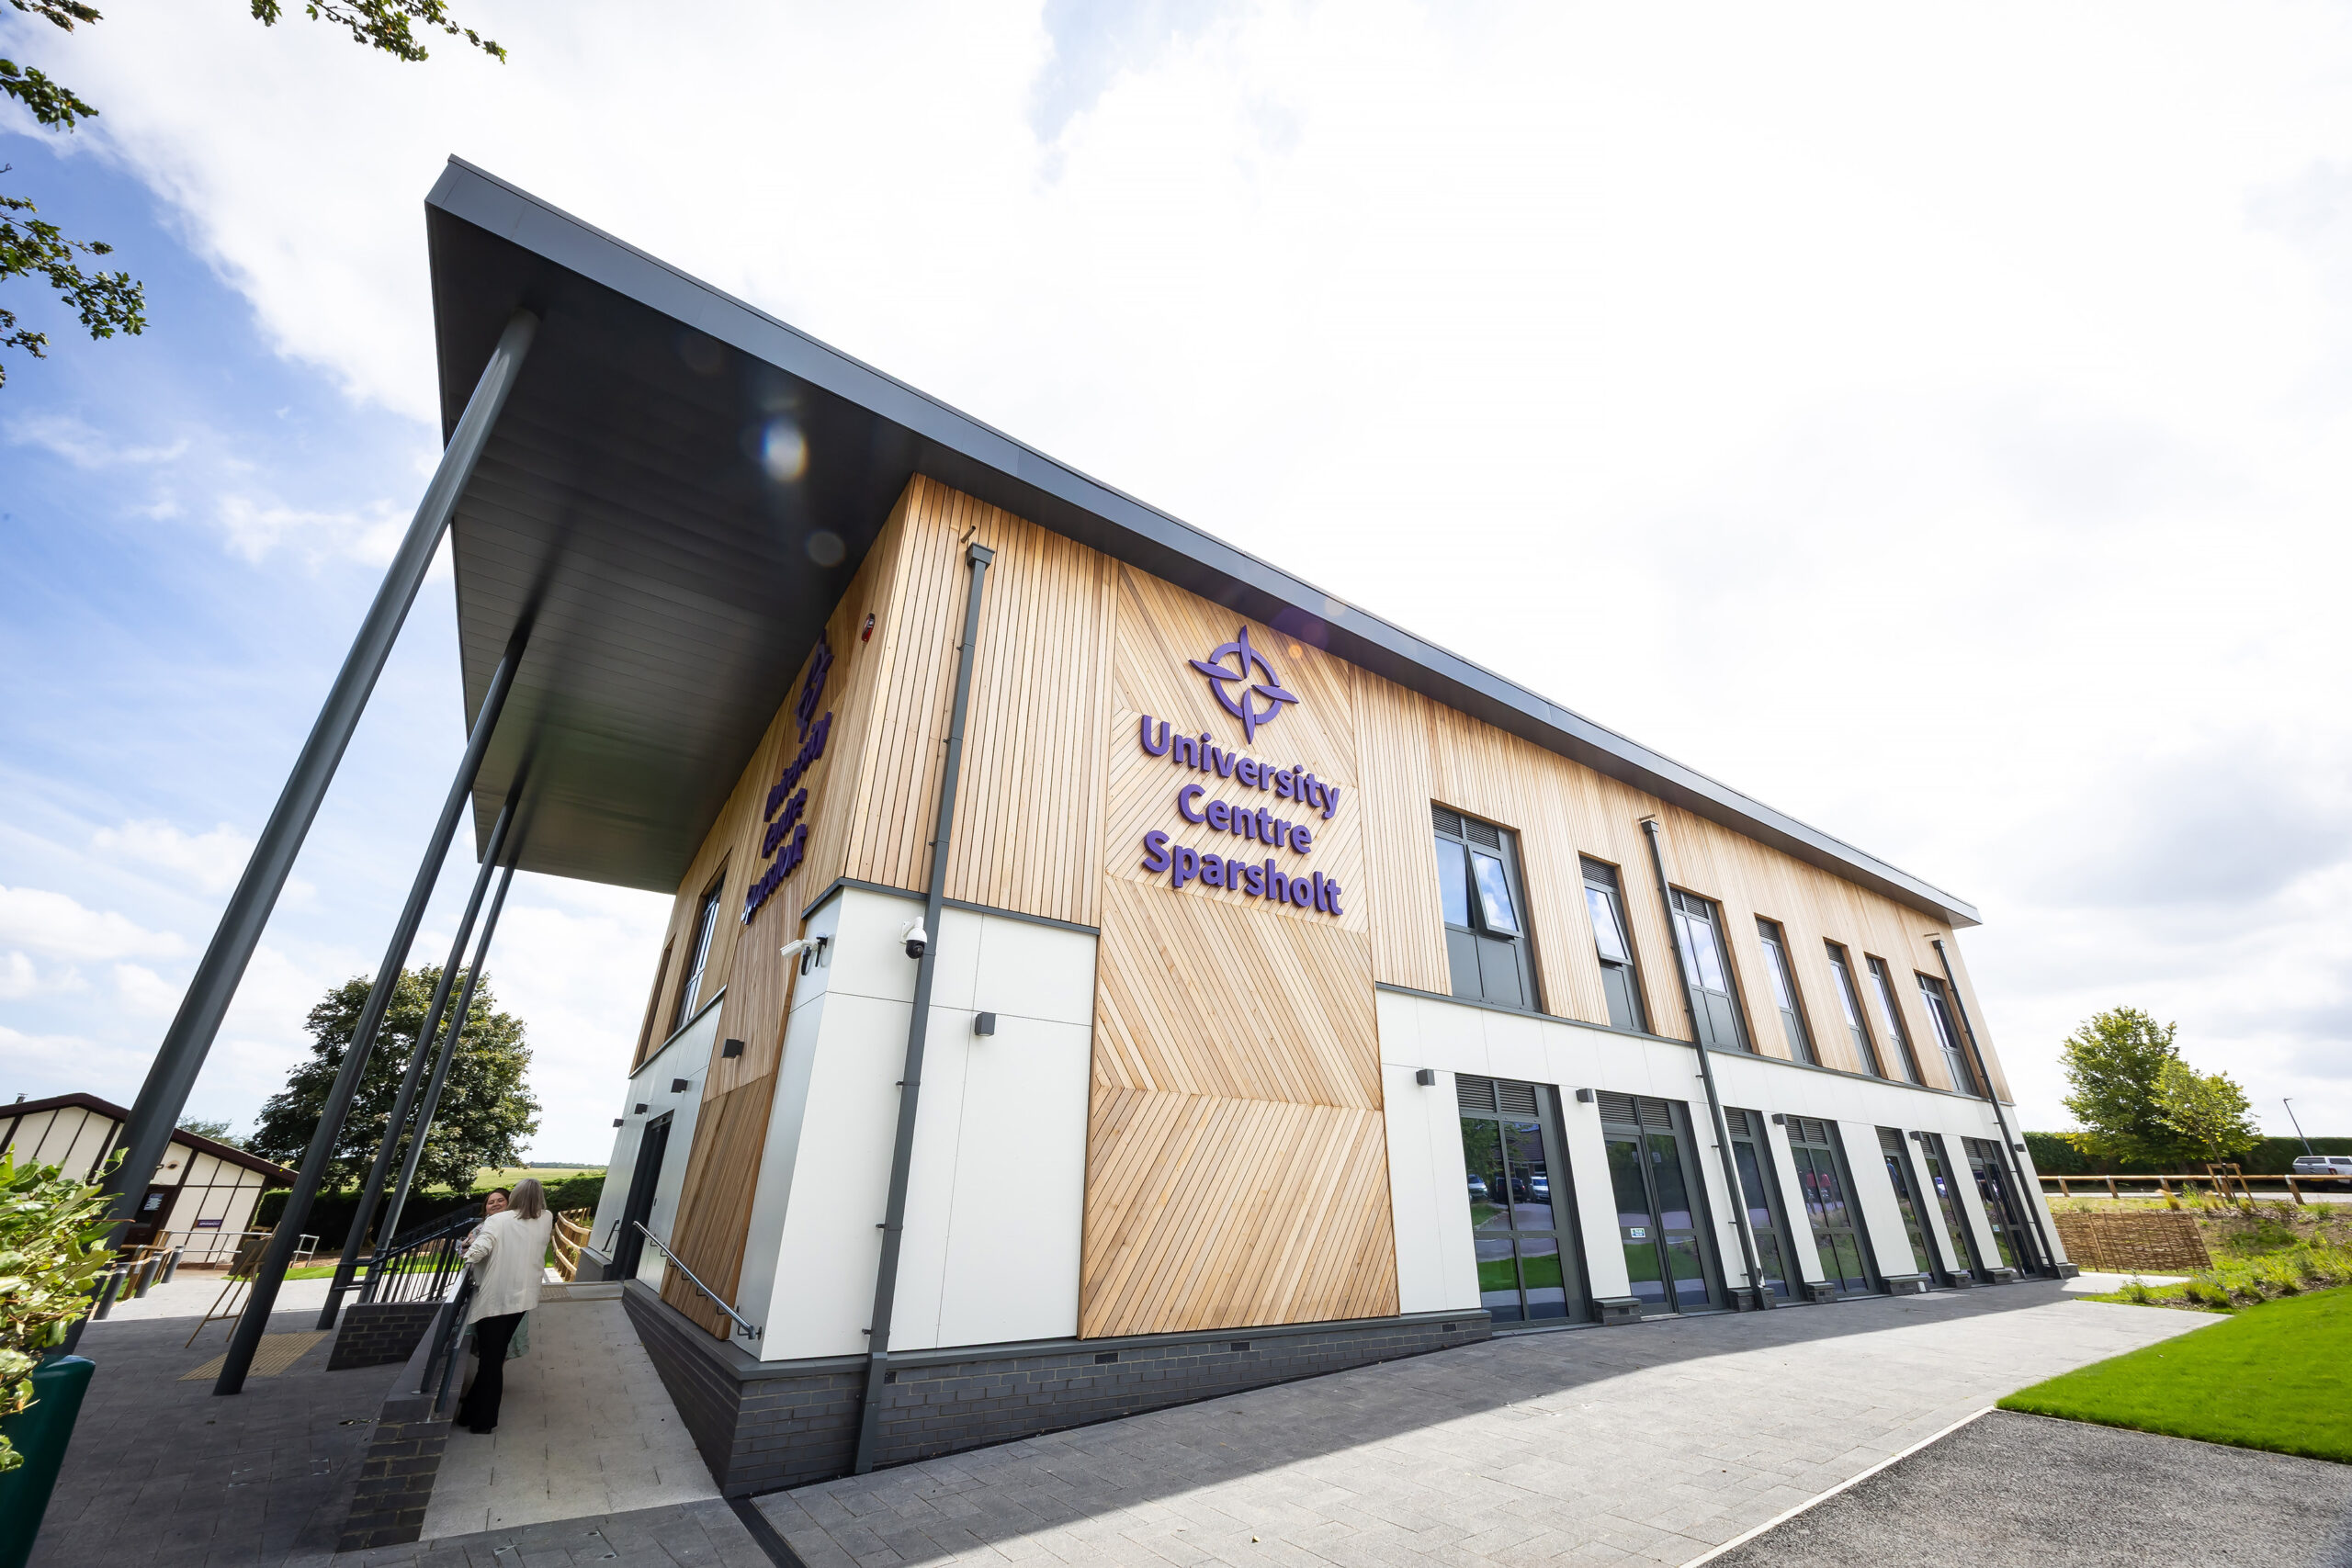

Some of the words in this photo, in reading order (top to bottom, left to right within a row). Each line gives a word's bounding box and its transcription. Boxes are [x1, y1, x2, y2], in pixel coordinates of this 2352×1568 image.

[1141, 714, 1340, 819] University
[1178, 784, 1313, 854] Centre
[1142, 829, 1344, 916] Sparsholt
